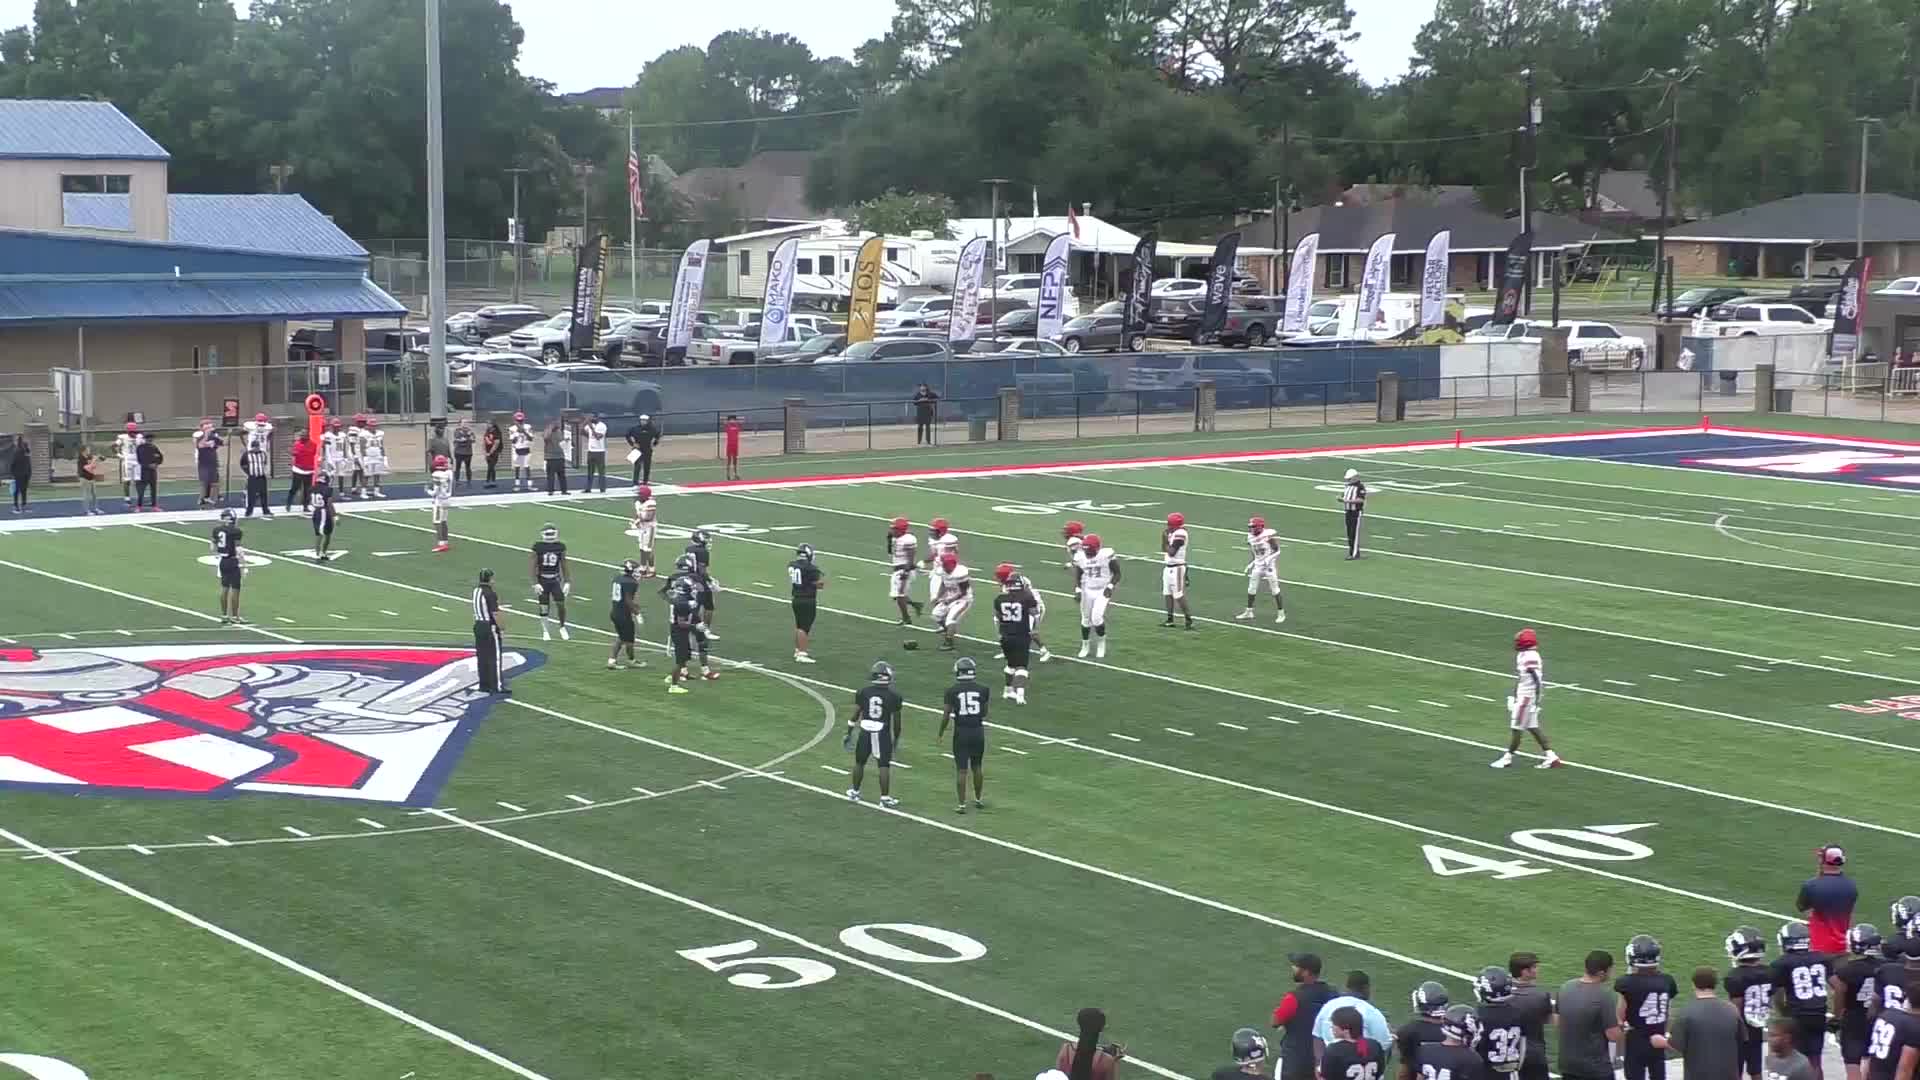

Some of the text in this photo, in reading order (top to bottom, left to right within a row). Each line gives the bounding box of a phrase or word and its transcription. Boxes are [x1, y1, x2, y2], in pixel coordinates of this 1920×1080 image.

[768, 260, 783, 306] MAKO
[1040, 271, 1059, 320] NFP
[1211, 264, 1227, 305] wave
[217, 531, 227, 548] 3
[1001, 602, 1022, 622] 53
[868, 696, 883, 719] 6
[957, 691, 981, 716] 15
[1791, 963, 1828, 1000] 83
[1487, 1026, 1522, 1063] 32
